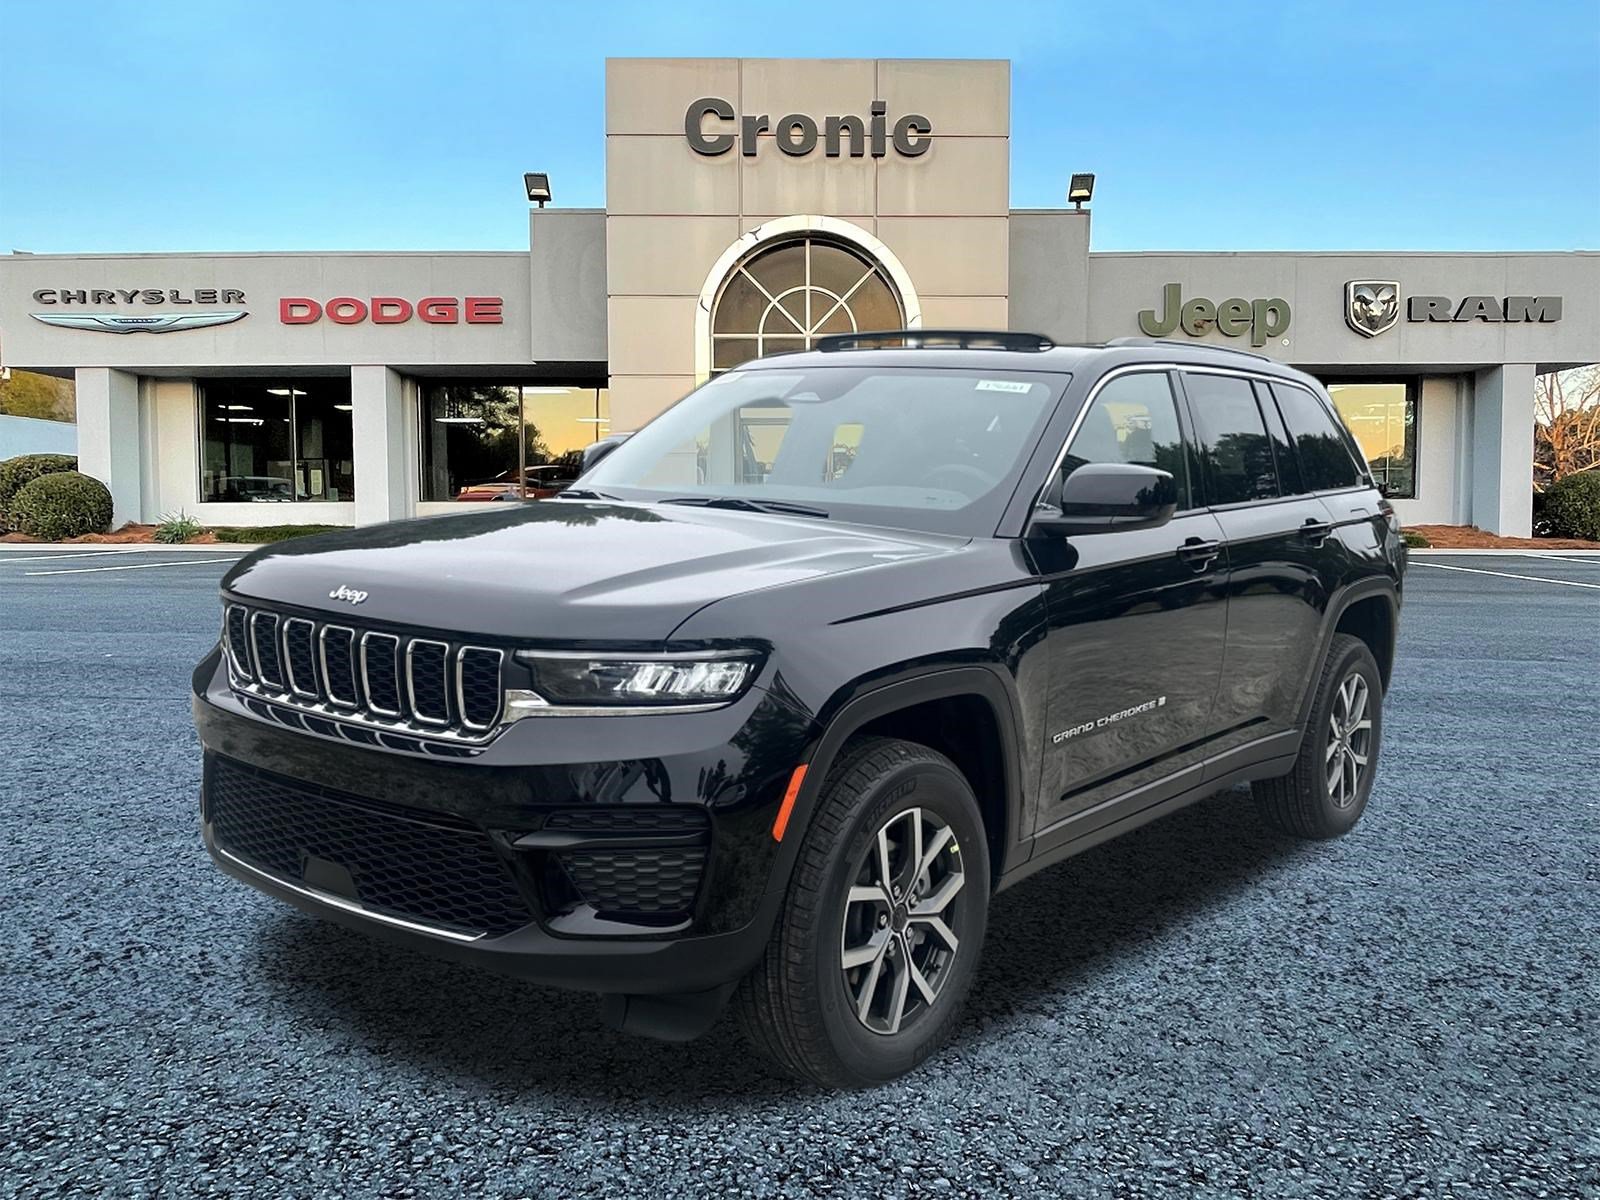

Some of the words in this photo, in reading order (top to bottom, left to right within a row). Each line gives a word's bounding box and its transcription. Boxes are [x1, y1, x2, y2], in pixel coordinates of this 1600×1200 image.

[684, 97, 932, 158] Cronic
[32, 288, 247, 305] CHRYSLER
[1407, 295, 1563, 323] RAM
[279, 297, 504, 325] DODGE
[1138, 283, 1292, 348] Jeep
[328, 584, 369, 605] Jeep
[1052, 722, 1095, 744] GRAND
[1096, 700, 1157, 728] CHEROKEE
